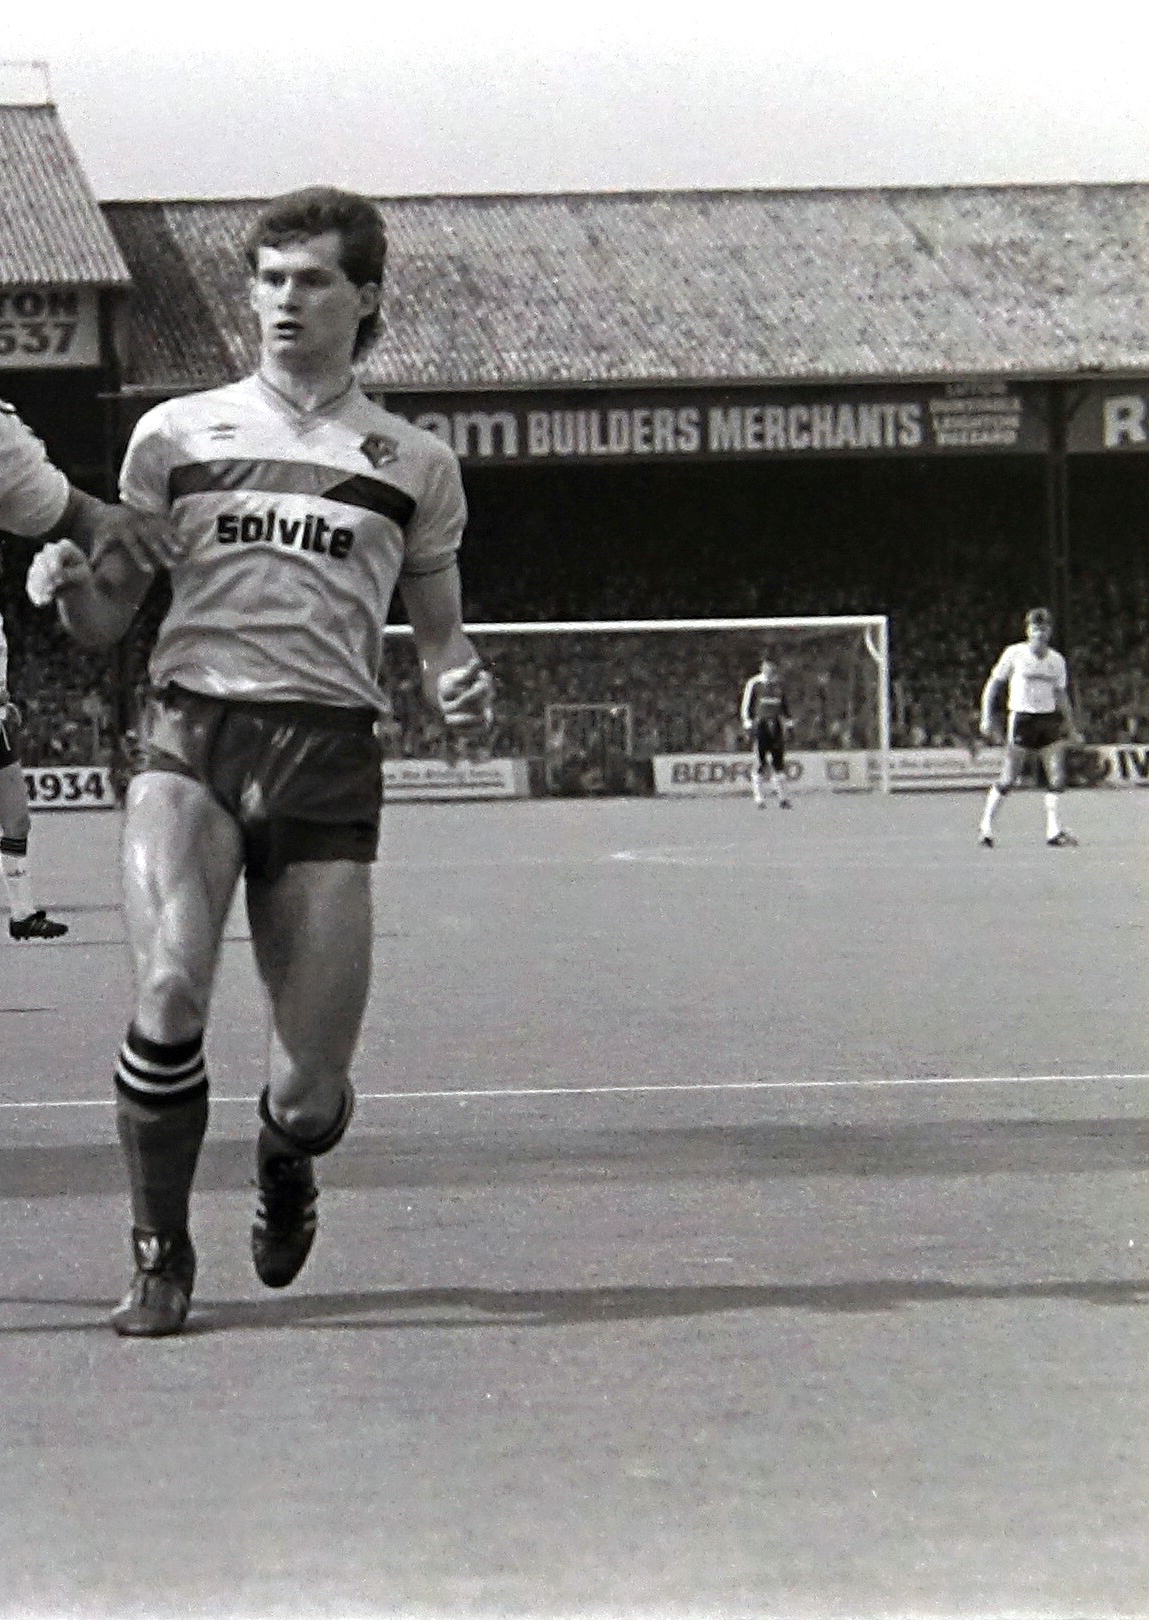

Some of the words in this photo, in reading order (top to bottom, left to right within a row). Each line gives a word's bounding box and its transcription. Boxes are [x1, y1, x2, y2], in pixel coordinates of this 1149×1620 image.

[526, 407, 700, 457] BUILDERS
[705, 403, 923, 453] MERCHANTS
[216, 509, 356, 560] solvite
[24, 772, 105, 801] 1934
[671, 762, 804, 784] BEDFD
